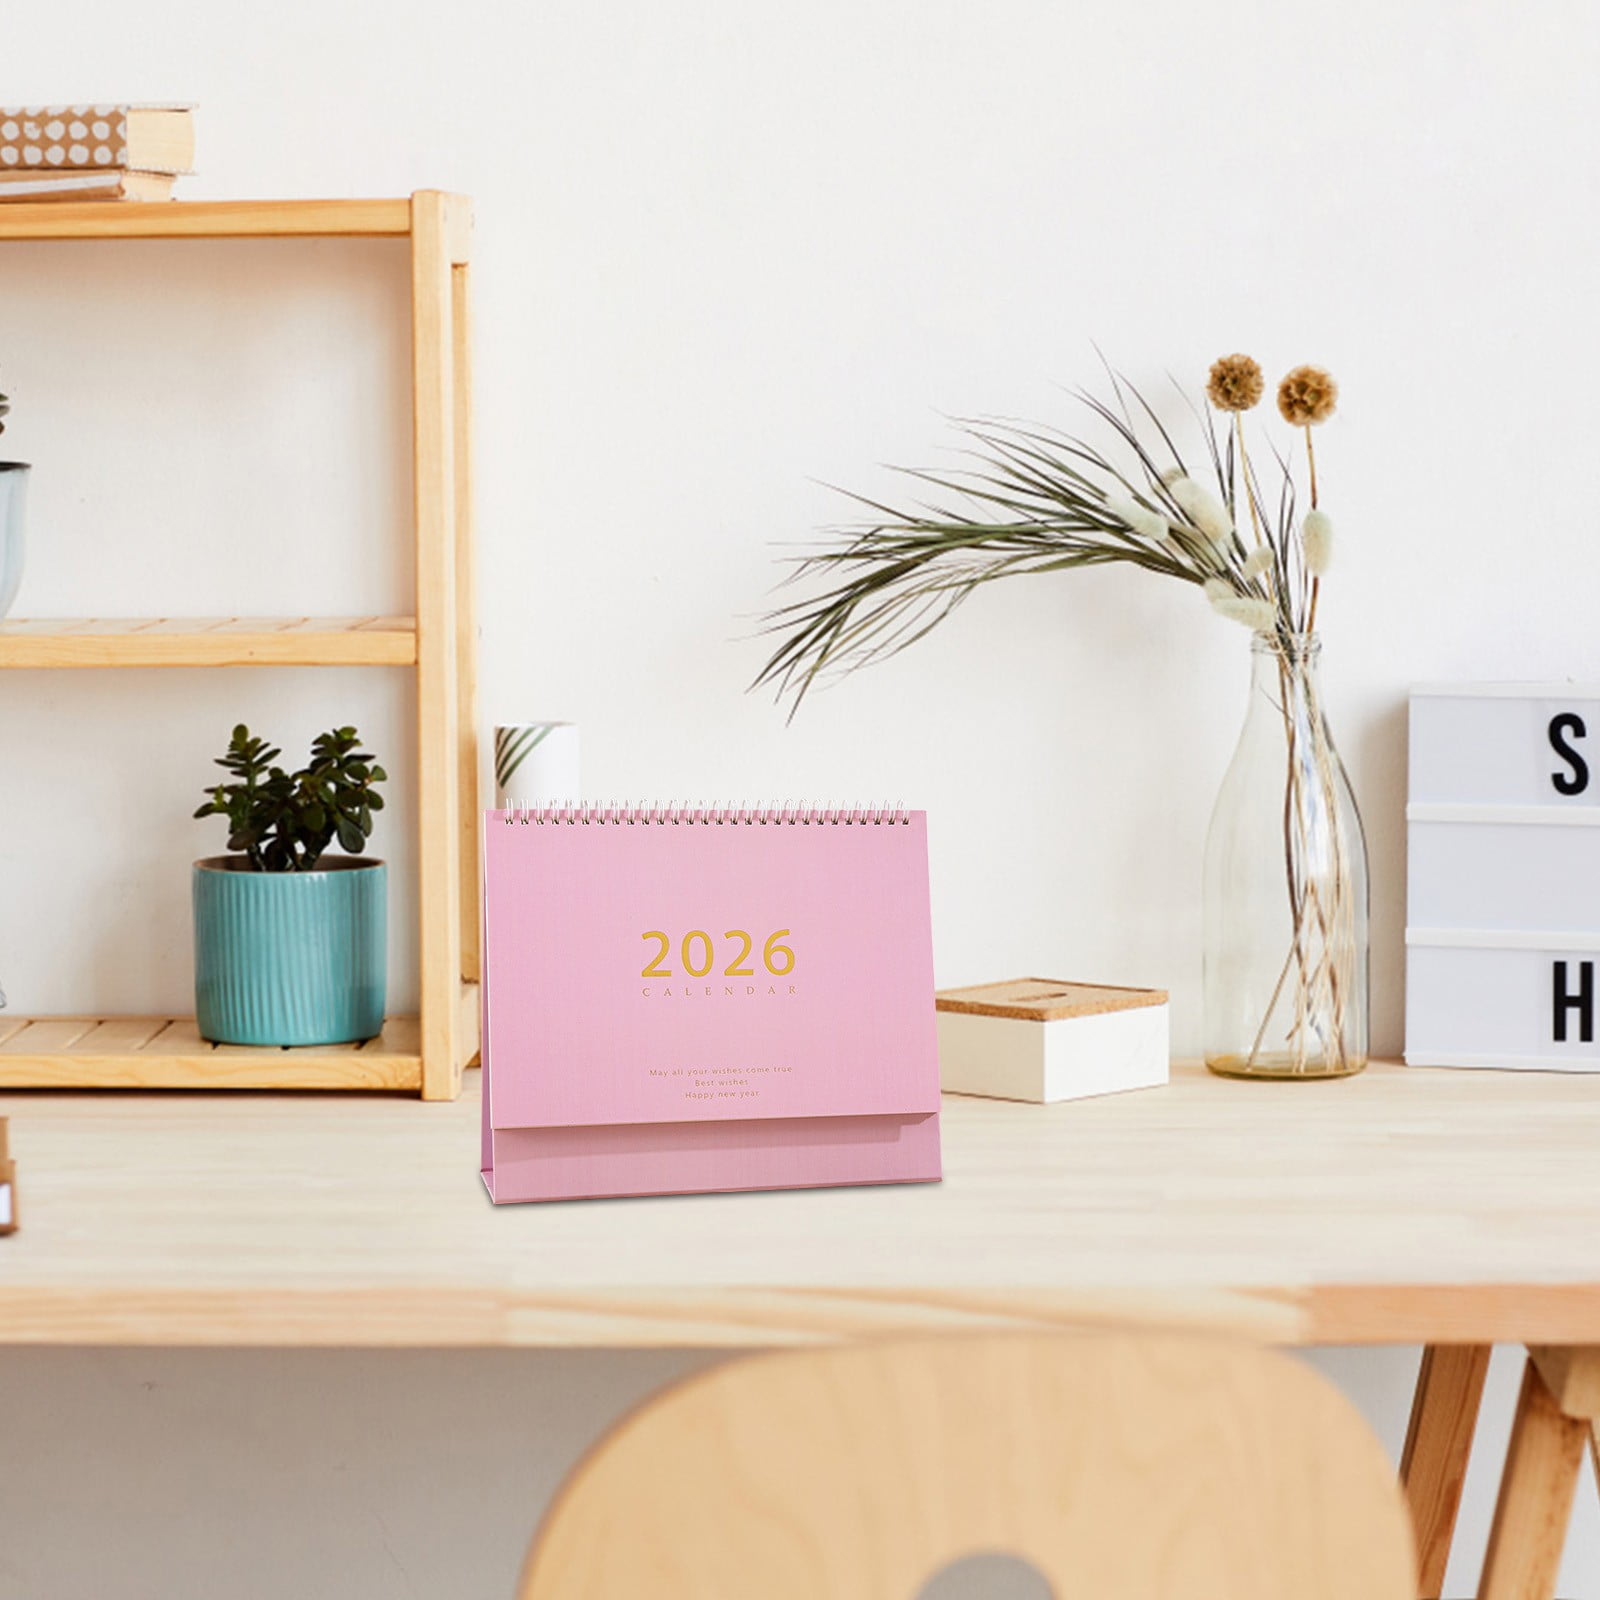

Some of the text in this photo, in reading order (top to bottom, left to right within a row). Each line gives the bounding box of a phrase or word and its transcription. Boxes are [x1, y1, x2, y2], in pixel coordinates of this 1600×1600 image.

[1547, 711, 1590, 796] S
[641, 928, 795, 977] 2026
[642, 986, 798, 998] CALENDAR
[1552, 960, 1594, 1043] H
[649, 1064, 793, 1078] May all your wishes come true
[694, 1077, 750, 1087] Best wishes
[685, 1089, 760, 1100] Happy new year
